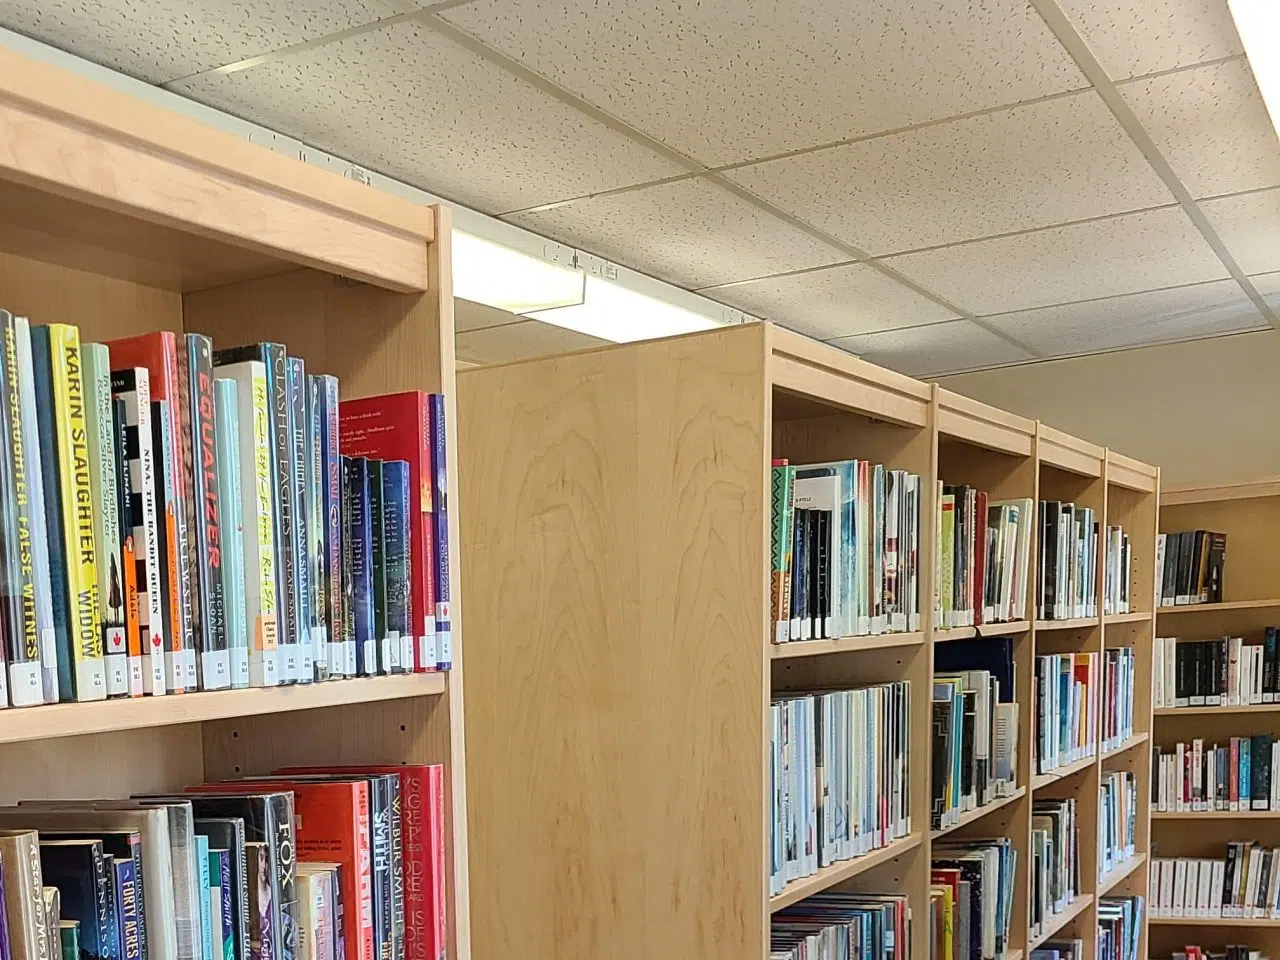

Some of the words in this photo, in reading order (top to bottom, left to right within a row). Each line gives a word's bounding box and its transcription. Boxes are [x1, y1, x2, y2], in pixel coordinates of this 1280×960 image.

[65, 346, 84, 420] KARIN
[103, 374, 109, 388] In
[97, 378, 106, 441] Rebecca
[105, 420, 113, 455] Land
[120, 423, 128, 455] LEILA
[100, 444, 108, 483] Silver
[107, 460, 114, 472] of
[122, 457, 131, 508] SLIMANI
[198, 371, 221, 569] EQUALIZER
[71, 427, 96, 565] SLAUGHTER
[101, 487, 111, 538] Slayter
[108, 476, 118, 545] Birdfishes
[146, 489, 154, 516] THE
[19, 516, 32, 576] FALSE
[147, 519, 156, 569] BANDIT
[150, 572, 159, 615] QUEEN
[179, 523, 193, 640] BREWSTER
[23, 583, 39, 661] WITNES
[78, 590, 96, 658] WIDOW
[208, 592, 218, 635] SLOAN
[214, 582, 224, 643] MICHAEL
[278, 822, 294, 890] FOX
[373, 811, 387, 873] SMITH
[122, 880, 137, 918] FORTY
[125, 920, 140, 959] ACRES
